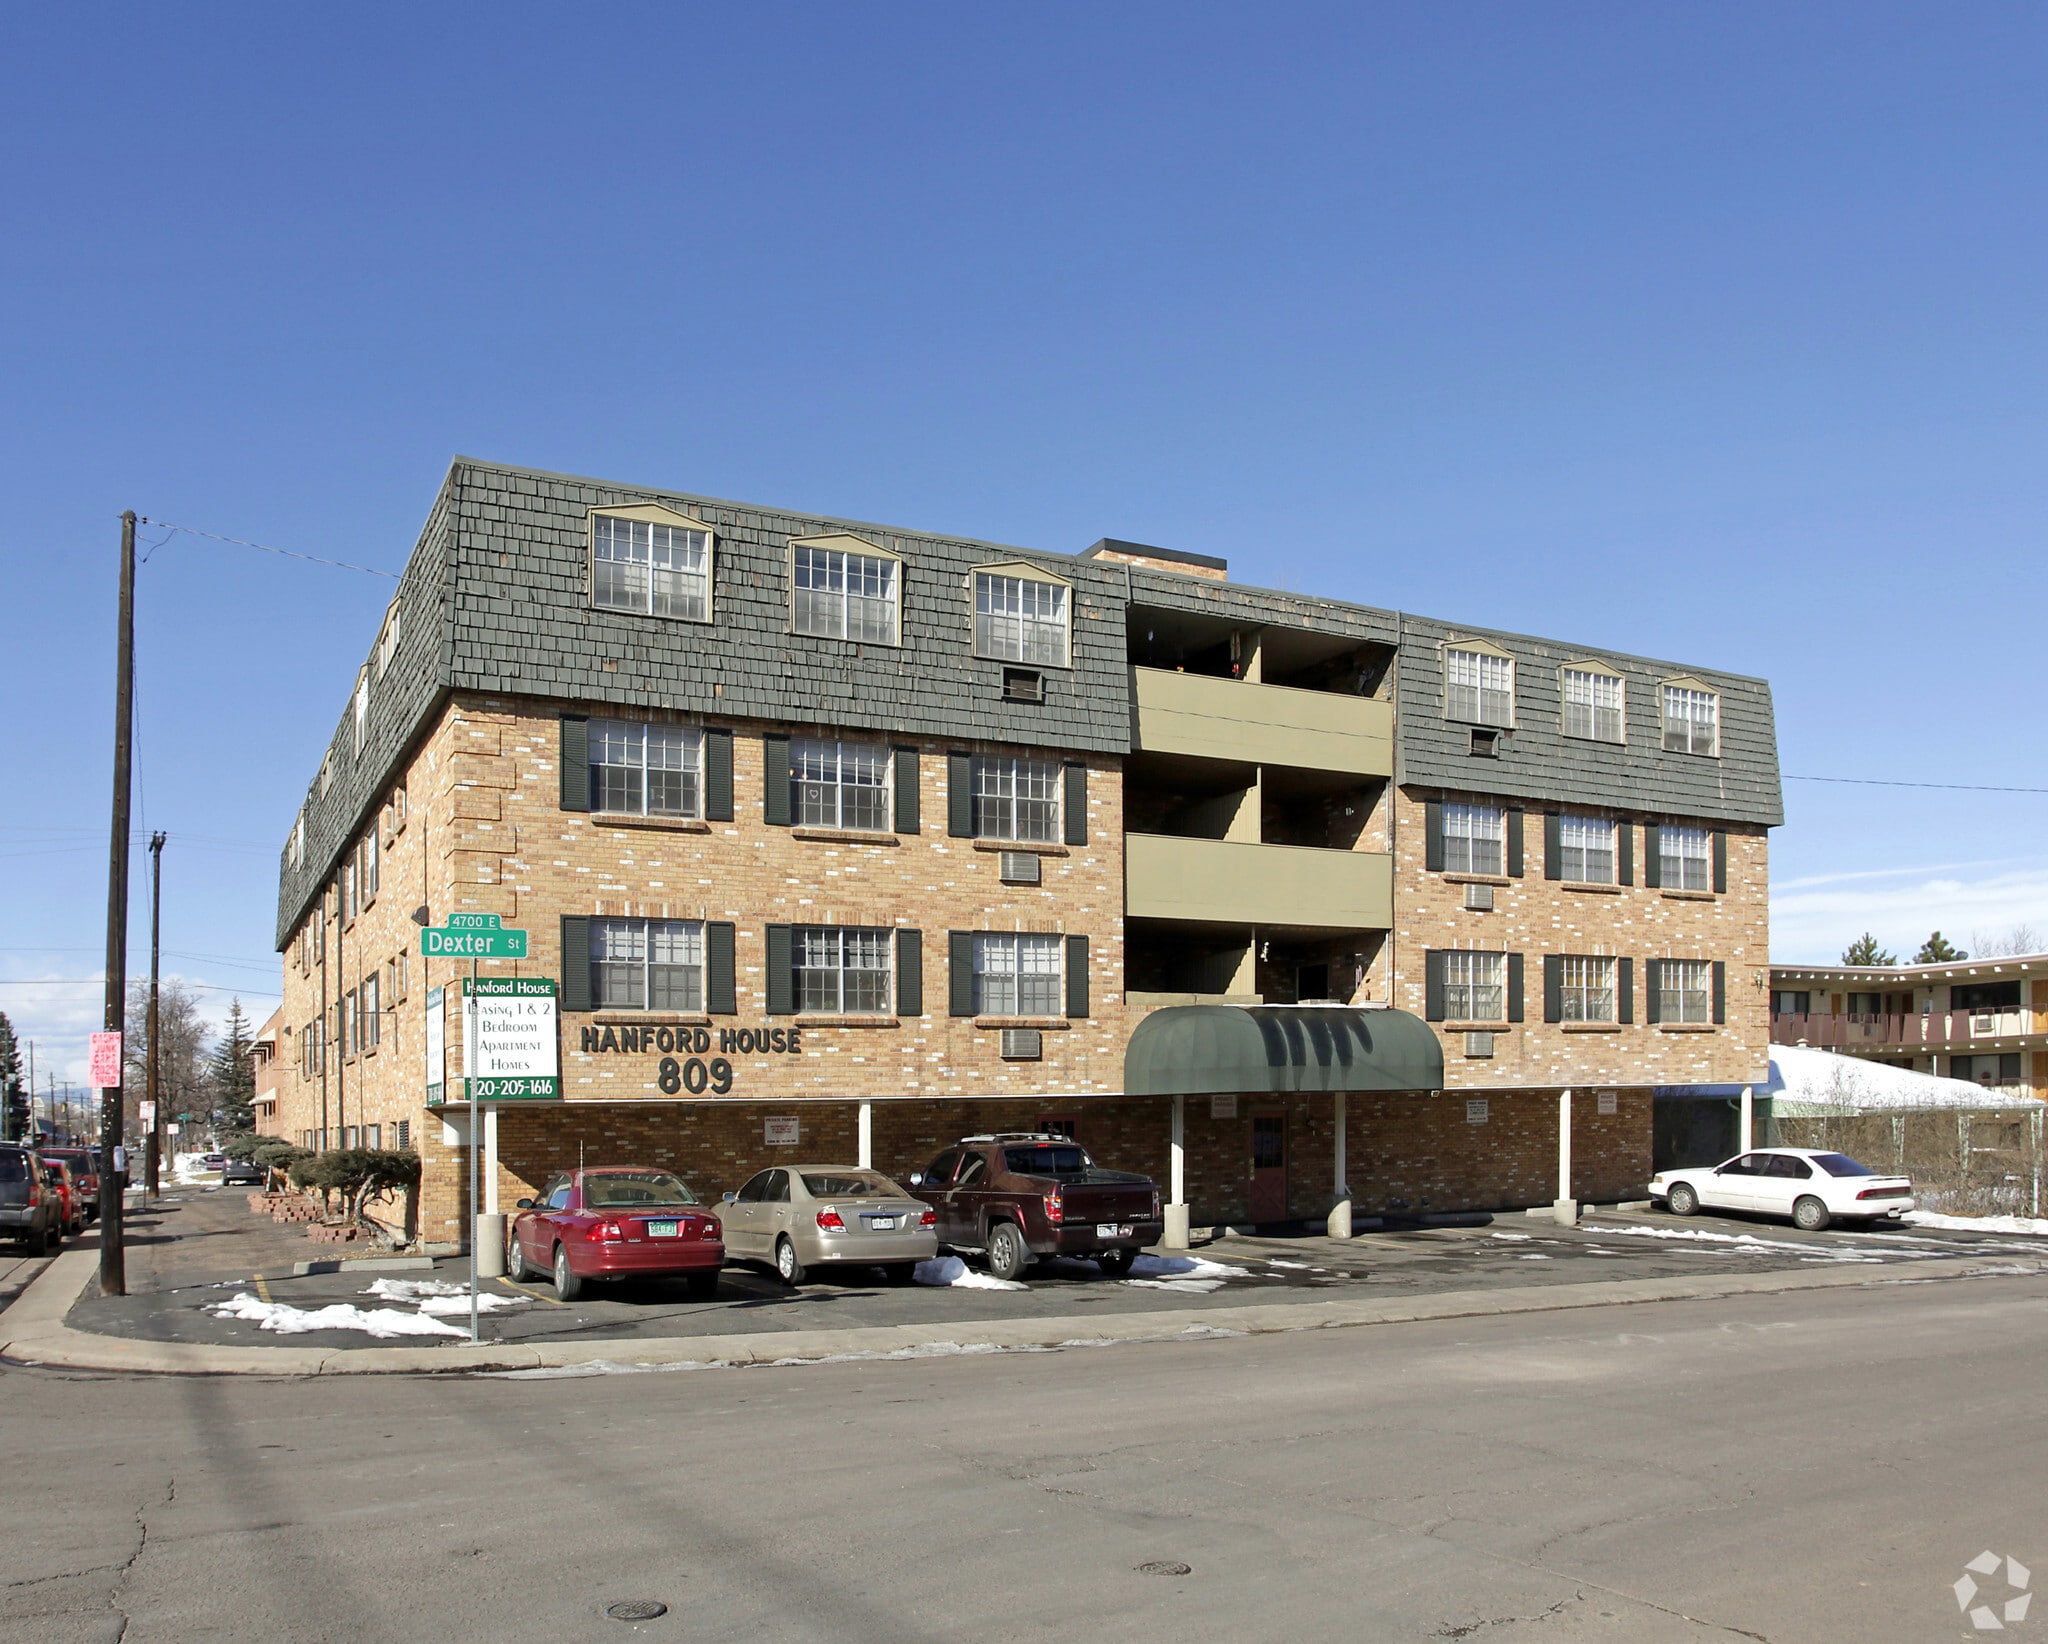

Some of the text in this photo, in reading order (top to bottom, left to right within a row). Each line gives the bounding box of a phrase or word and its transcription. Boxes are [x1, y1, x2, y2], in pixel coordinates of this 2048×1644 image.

[453, 916, 496, 927] 4700 E
[429, 932, 520, 953] Dexter St
[527, 1003, 536, 1015] &
[543, 1003, 550, 1015] 2
[581, 1026, 802, 1054] HANFORD HOUSE
[95, 1045, 117, 1053] JUNK
[658, 1057, 733, 1095] 809
[469, 1079, 553, 1096] 20-205-1616
